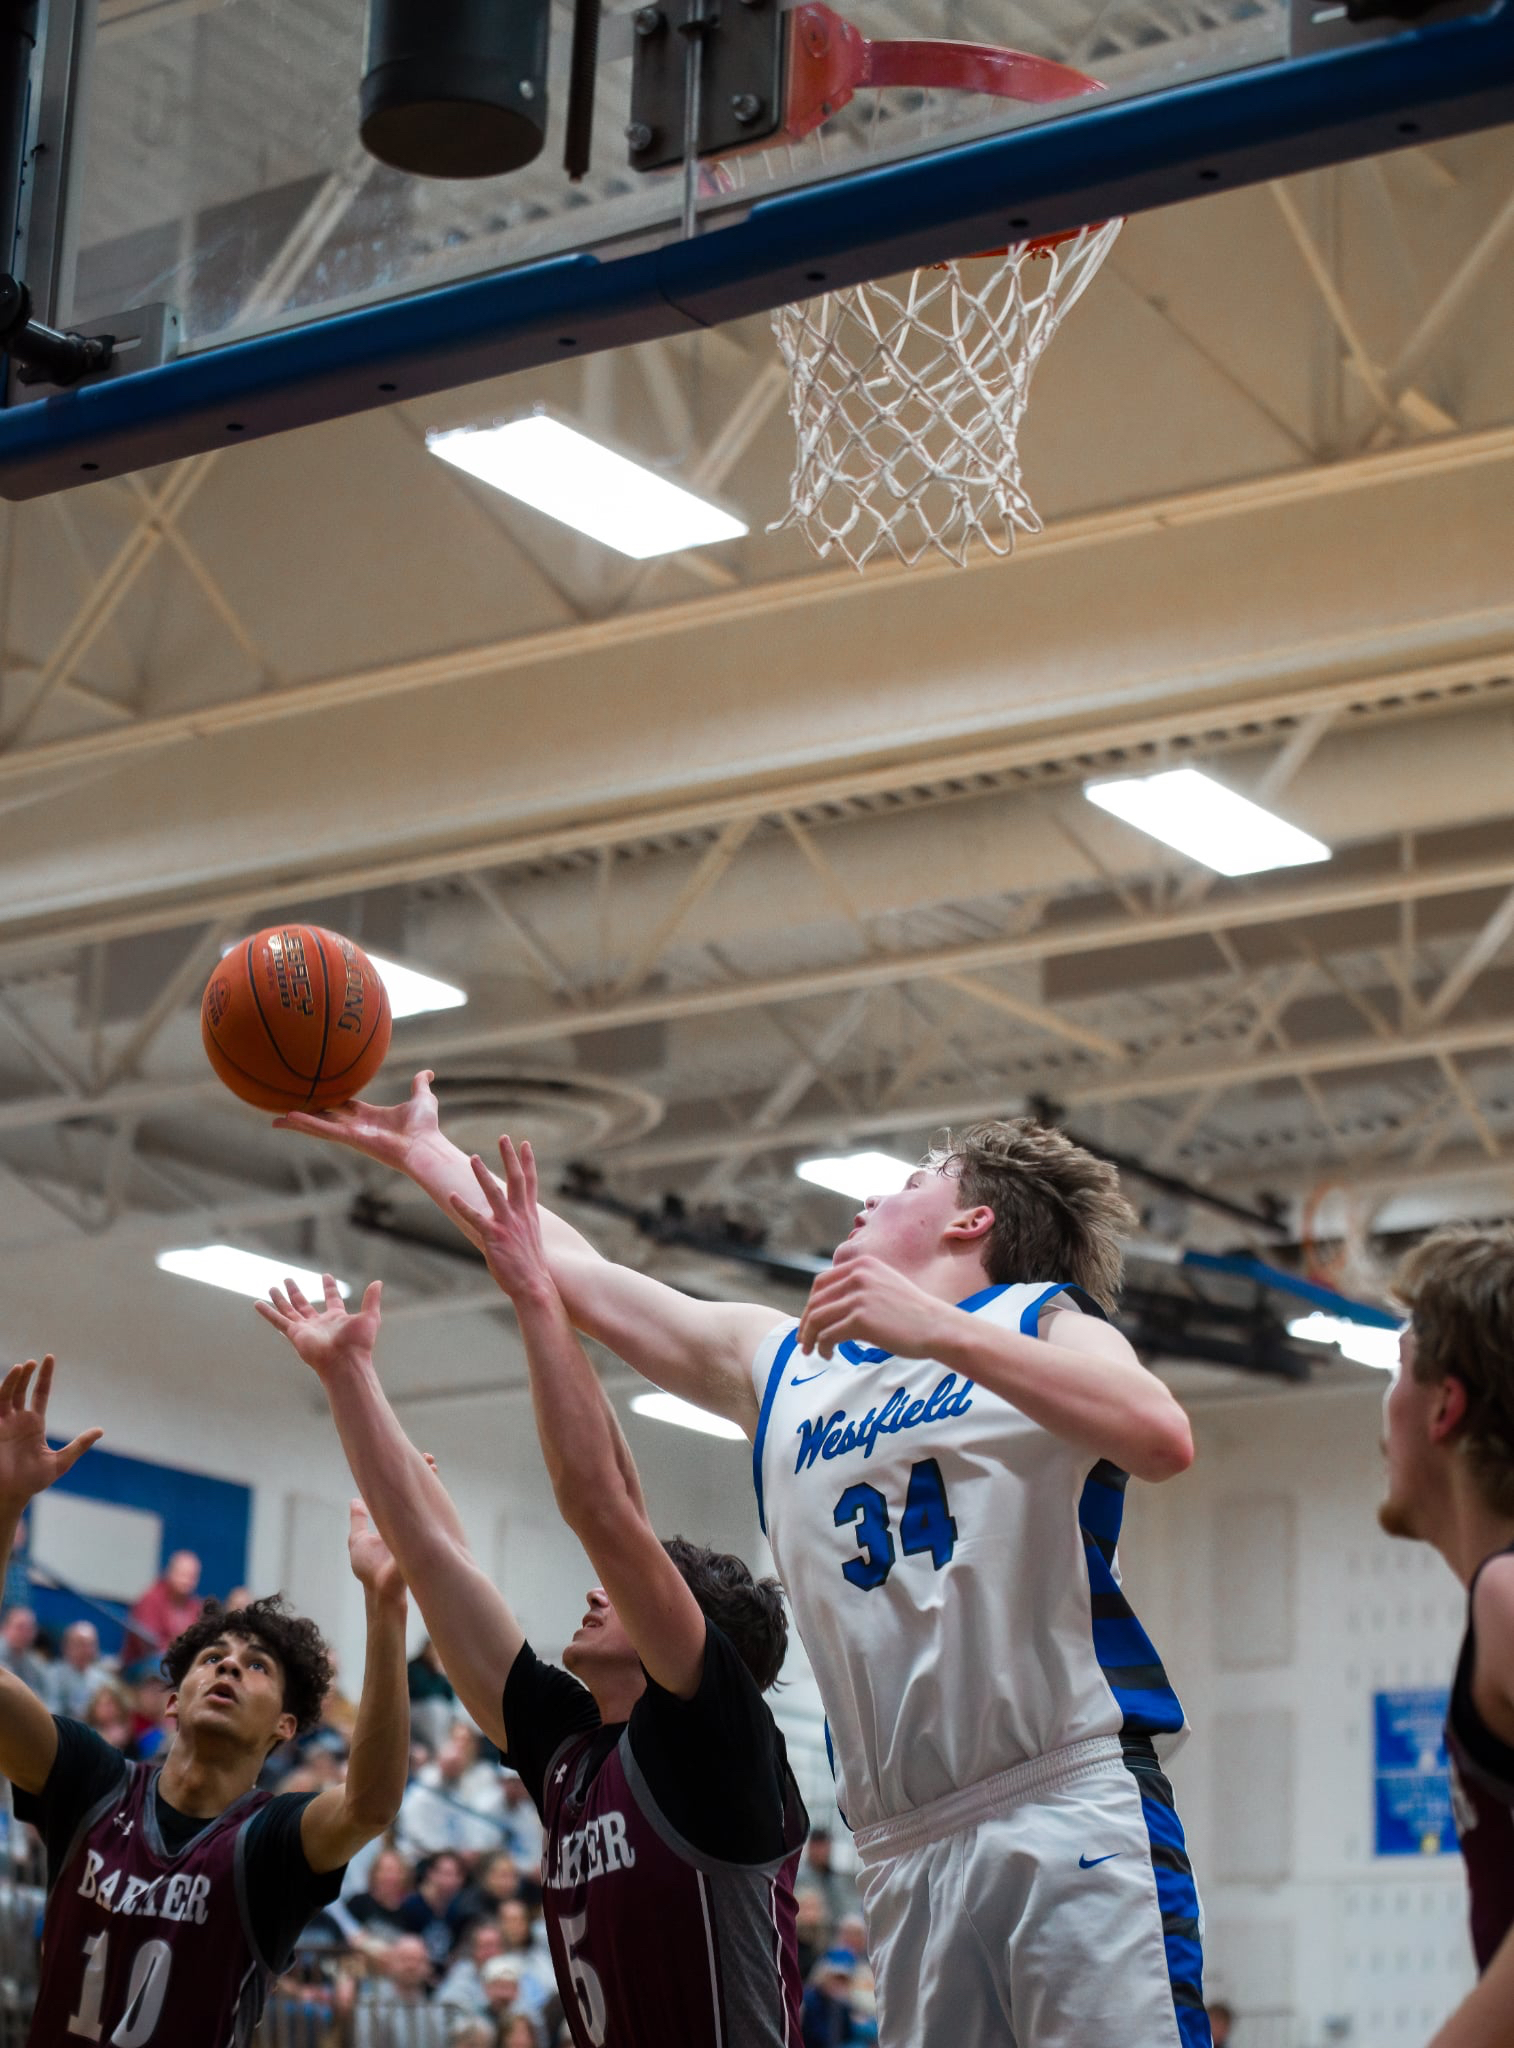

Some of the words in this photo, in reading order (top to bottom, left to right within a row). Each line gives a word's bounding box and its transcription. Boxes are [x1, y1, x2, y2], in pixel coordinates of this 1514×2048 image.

[282, 928, 315, 1016] LEGACY
[334, 936, 364, 1034] LDING
[795, 1372, 974, 1464] Westfield
[833, 1457, 958, 1592] 34
[67, 1928, 172, 2048] 10
[558, 1911, 606, 2048] 5
